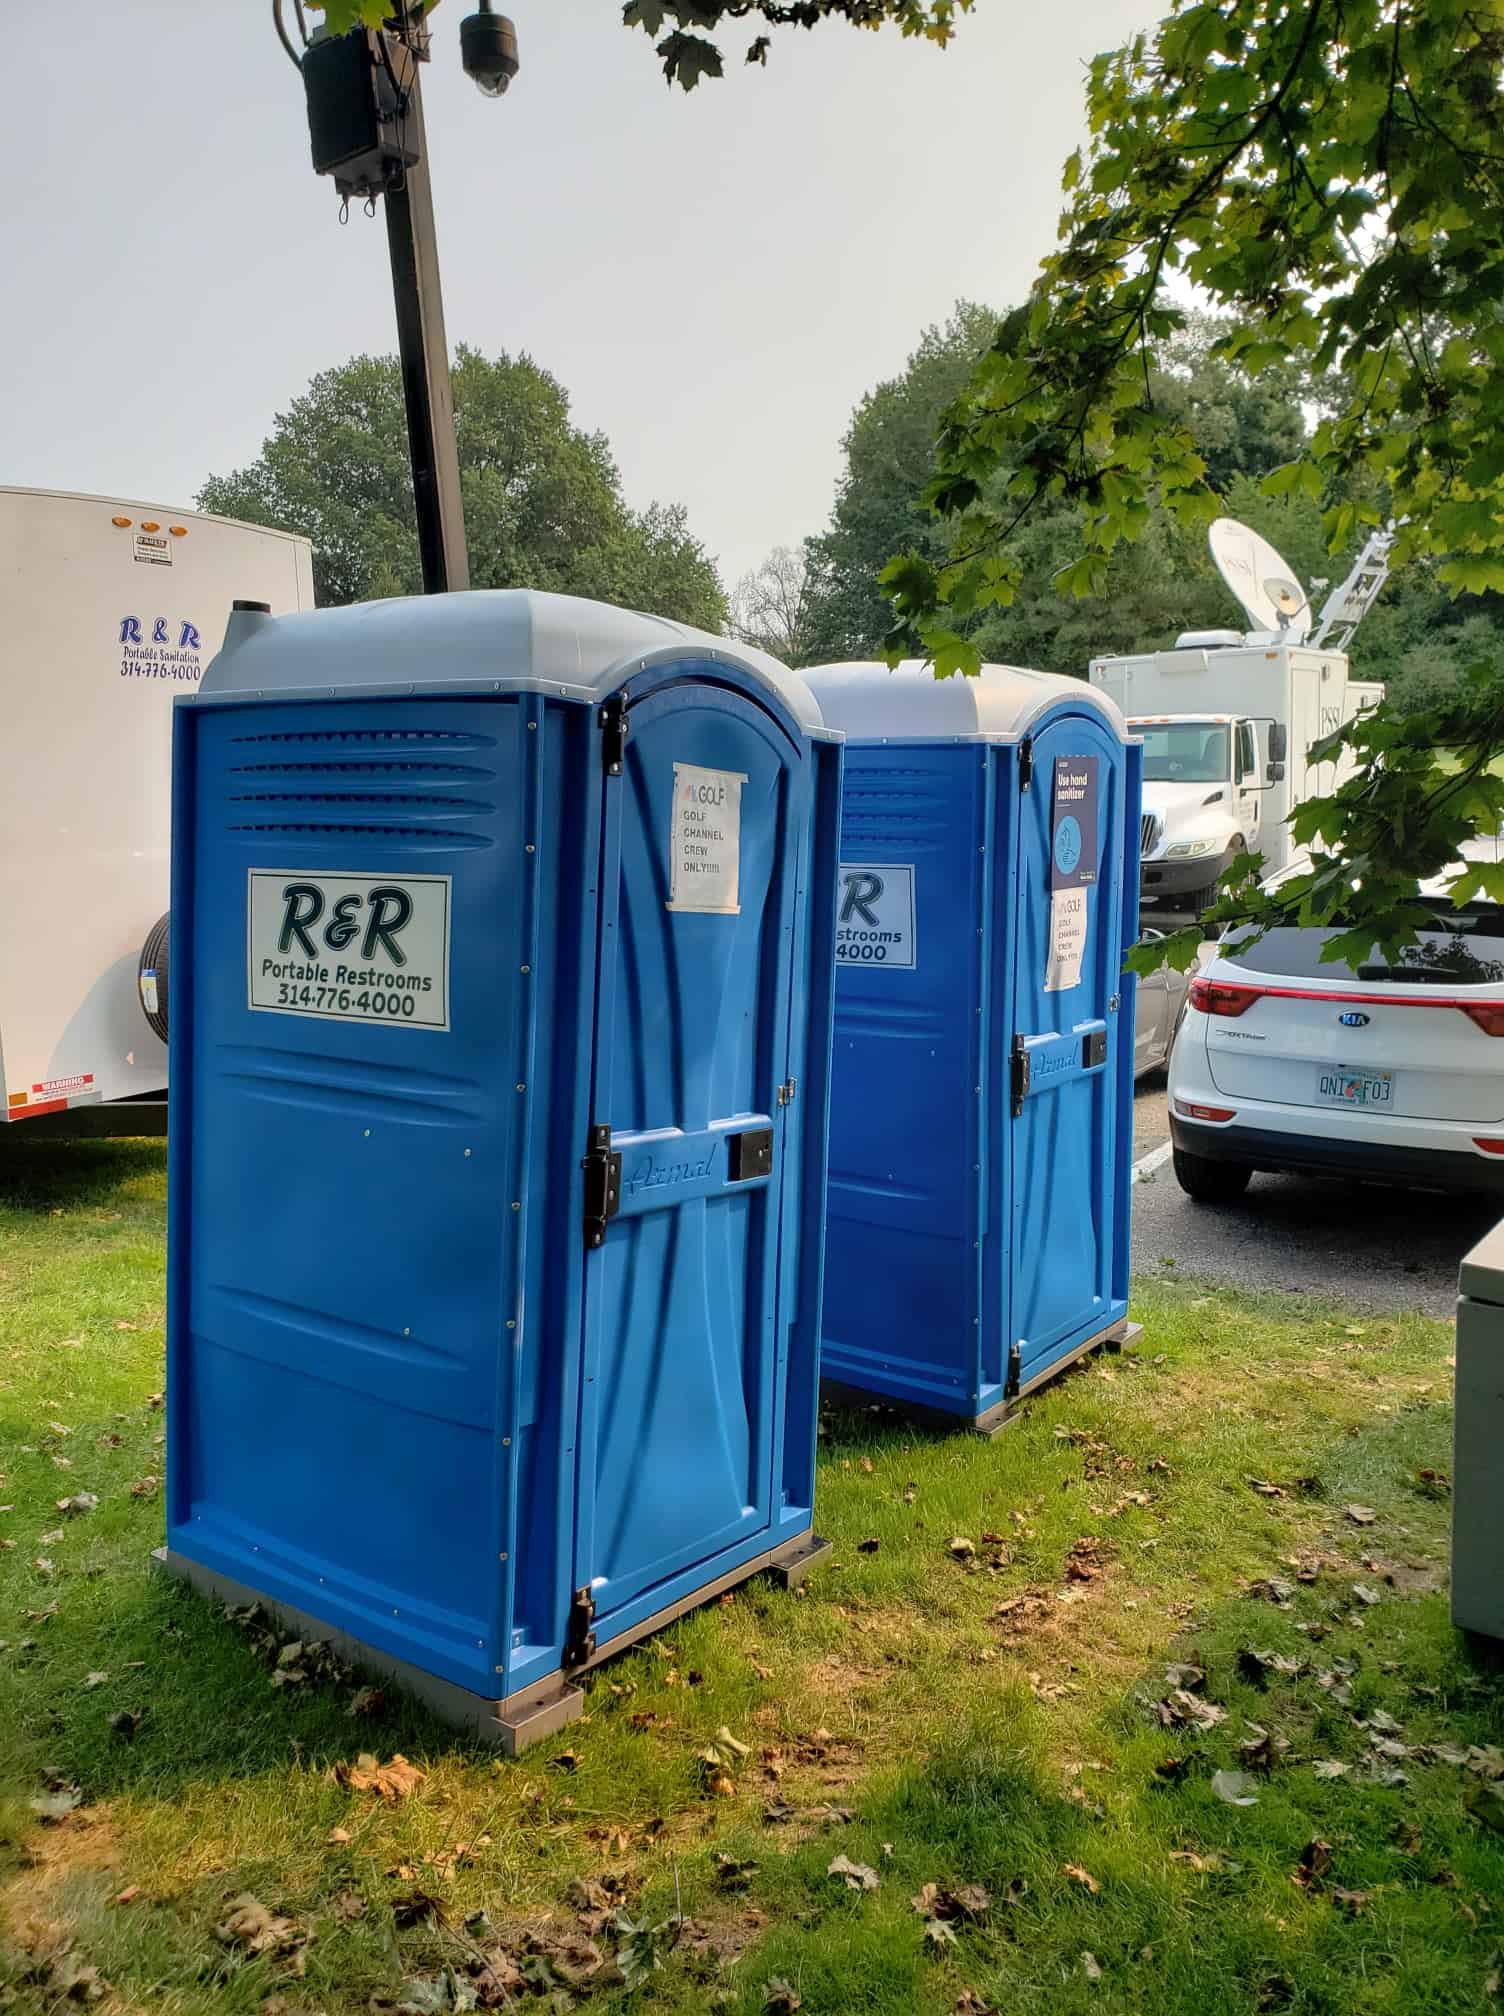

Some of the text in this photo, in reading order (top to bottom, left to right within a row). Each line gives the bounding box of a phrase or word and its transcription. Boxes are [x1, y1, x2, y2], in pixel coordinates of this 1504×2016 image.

[119, 616, 201, 650] R & R
[124, 646, 200, 664] Portable Sanitation
[1070, 772, 1088, 786] hand
[698, 785, 724, 806] GOLF
[1057, 787, 1085, 801] sanitizer
[683, 810, 706, 822] GOLF
[683, 827, 724, 841] CHANNEL
[684, 844, 708, 857] CREW
[262, 958, 433, 992] Portable Restrooms
[1342, 1014, 1366, 1025] KIA
